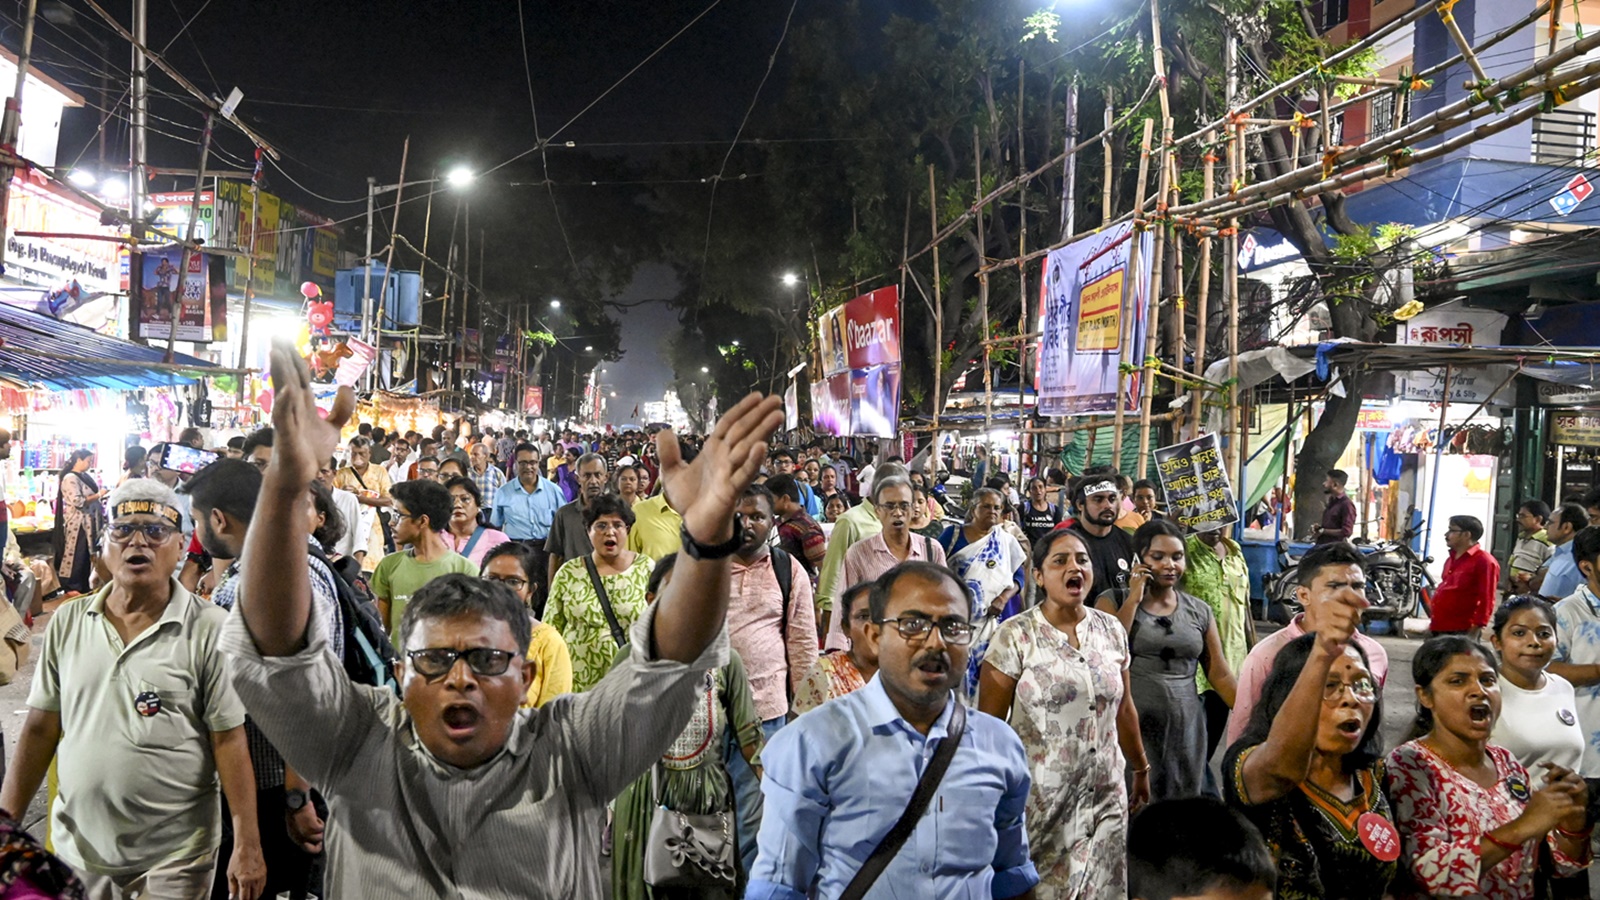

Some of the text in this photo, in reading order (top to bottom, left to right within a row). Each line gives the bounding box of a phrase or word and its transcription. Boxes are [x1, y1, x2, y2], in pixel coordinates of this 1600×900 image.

[1421, 322, 1473, 344] রূপসী
[1159, 448, 1217, 475] তুমিও মানুষ
[1166, 475, 1199, 490] আমিও
